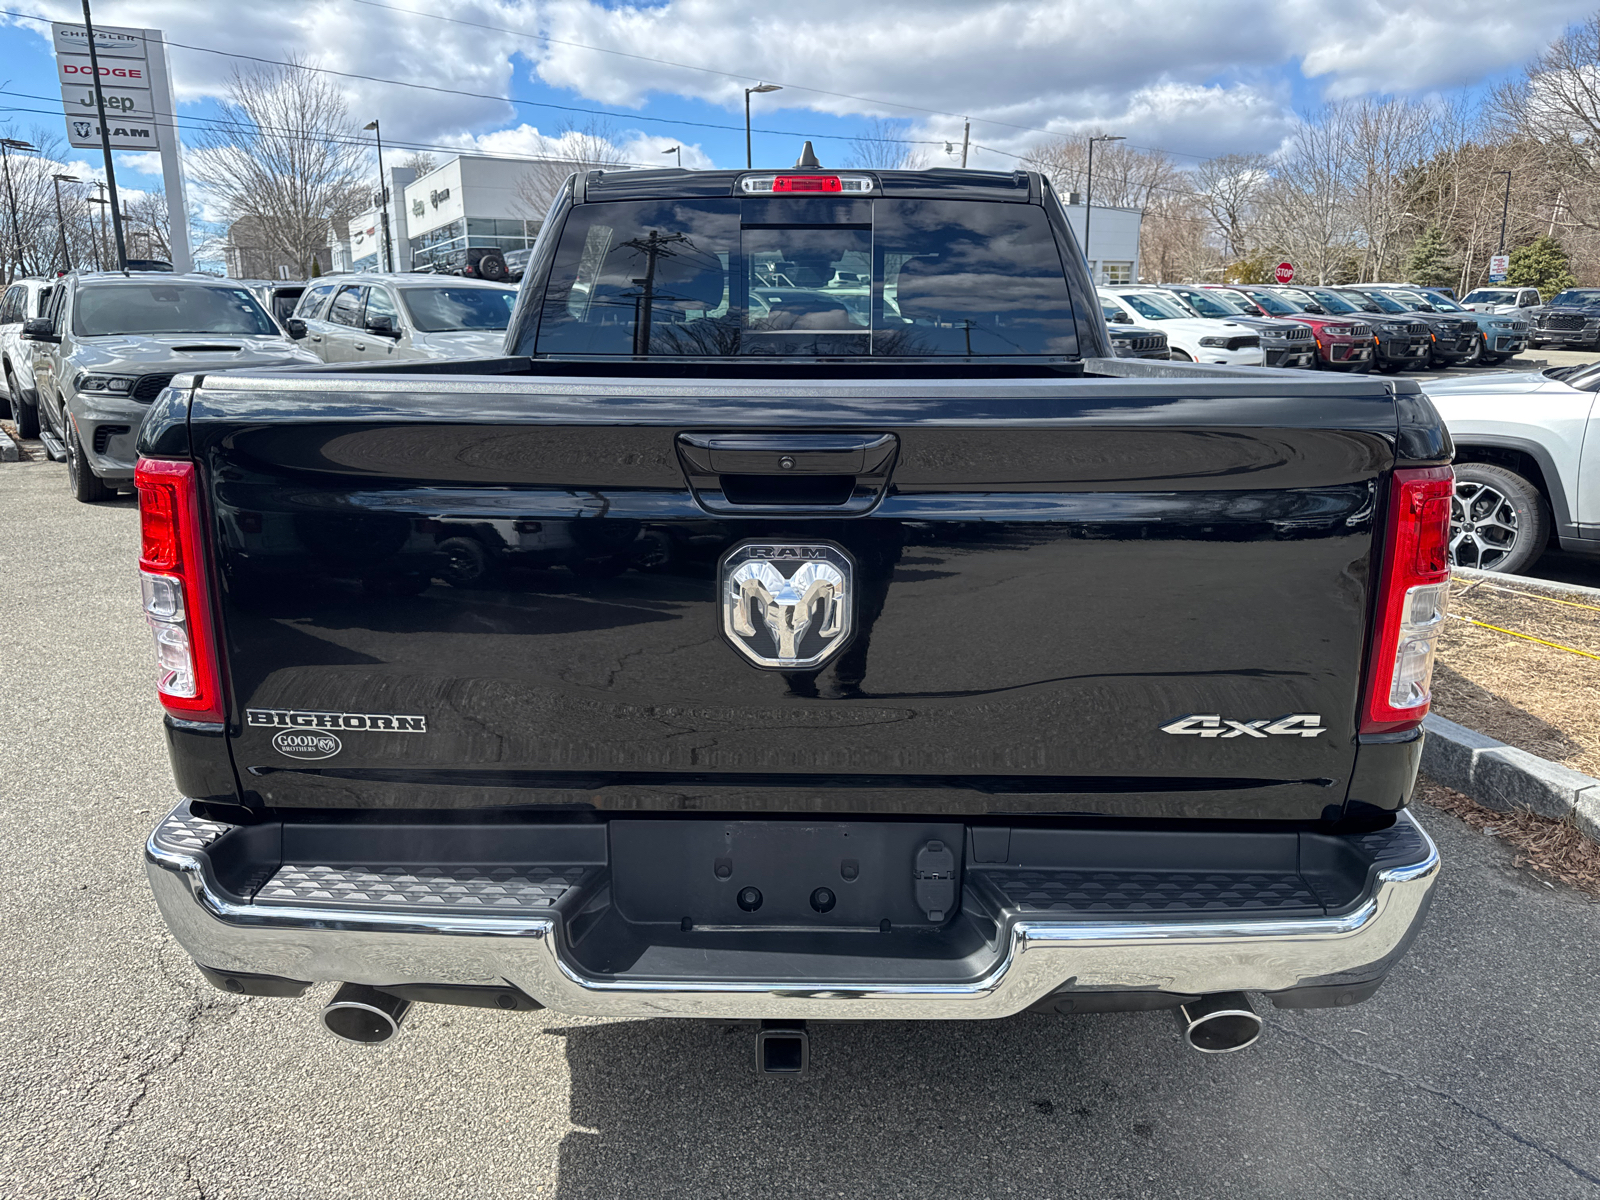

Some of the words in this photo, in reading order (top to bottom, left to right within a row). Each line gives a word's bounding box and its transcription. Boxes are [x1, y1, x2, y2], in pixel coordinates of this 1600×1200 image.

[60, 30, 136, 42] CHRYSLER
[63, 64, 143, 79] DODGE
[80, 90, 135, 113] Jeep
[1276, 267, 1293, 278] STOP
[749, 547, 826, 559] RAM
[246, 708, 428, 733] BIGHORN
[277, 735, 318, 747] GOOD
